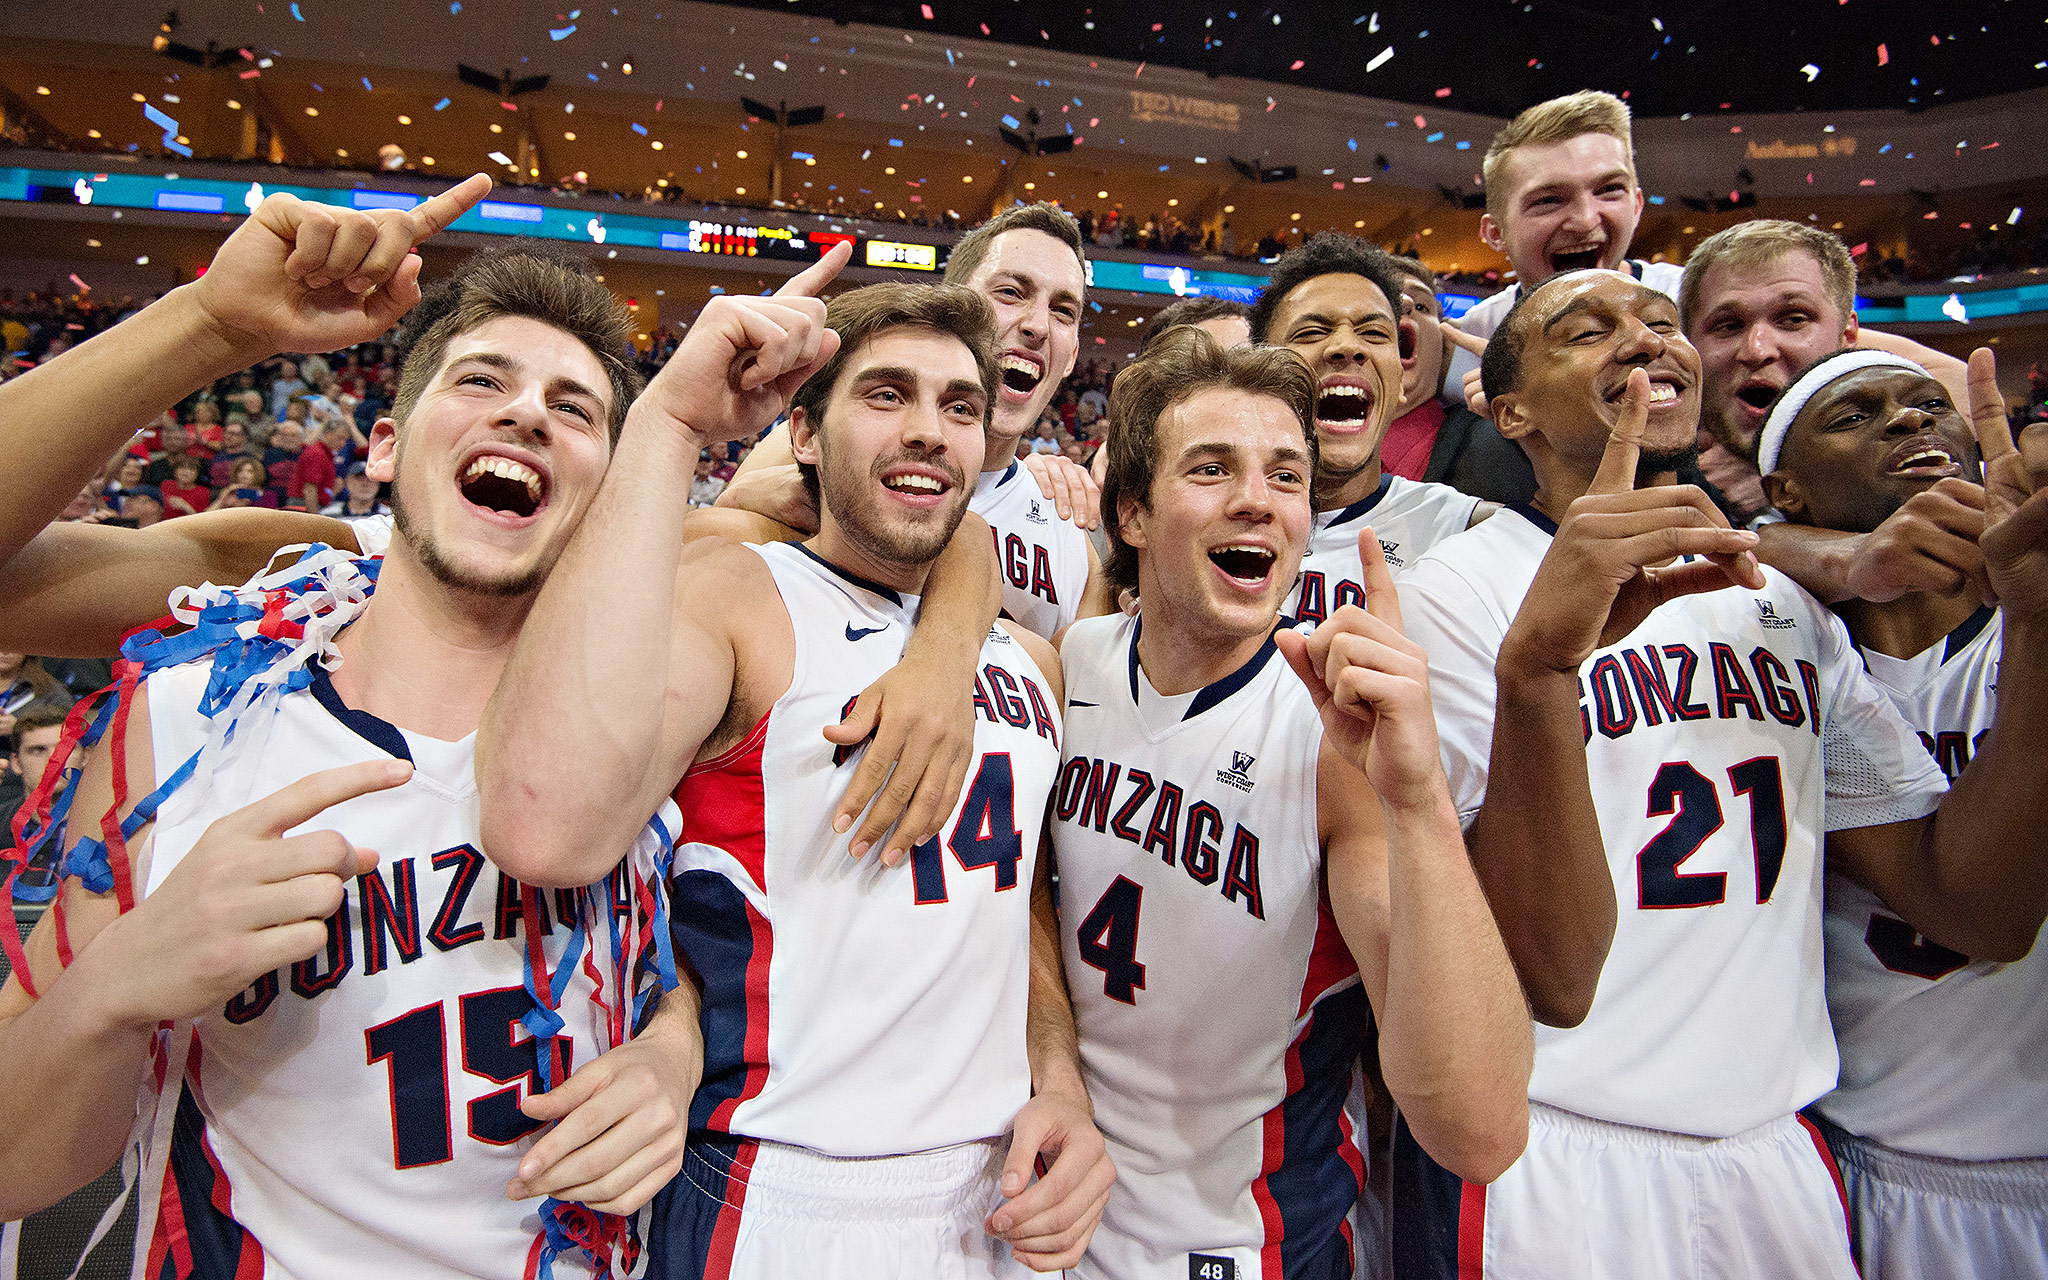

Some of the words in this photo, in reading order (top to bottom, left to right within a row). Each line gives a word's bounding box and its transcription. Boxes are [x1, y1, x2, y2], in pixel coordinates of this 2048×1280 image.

[1578, 641, 1820, 748] ONZAGA
[1056, 755, 1266, 921] ONZAGA
[1216, 769, 1237, 782] WEST
[1235, 776, 1255, 789] COAST
[1636, 756, 1787, 910] 21
[1077, 874, 1146, 1006] 4
[364, 972, 574, 1170] 15
[1199, 1262, 1224, 1280] 48
